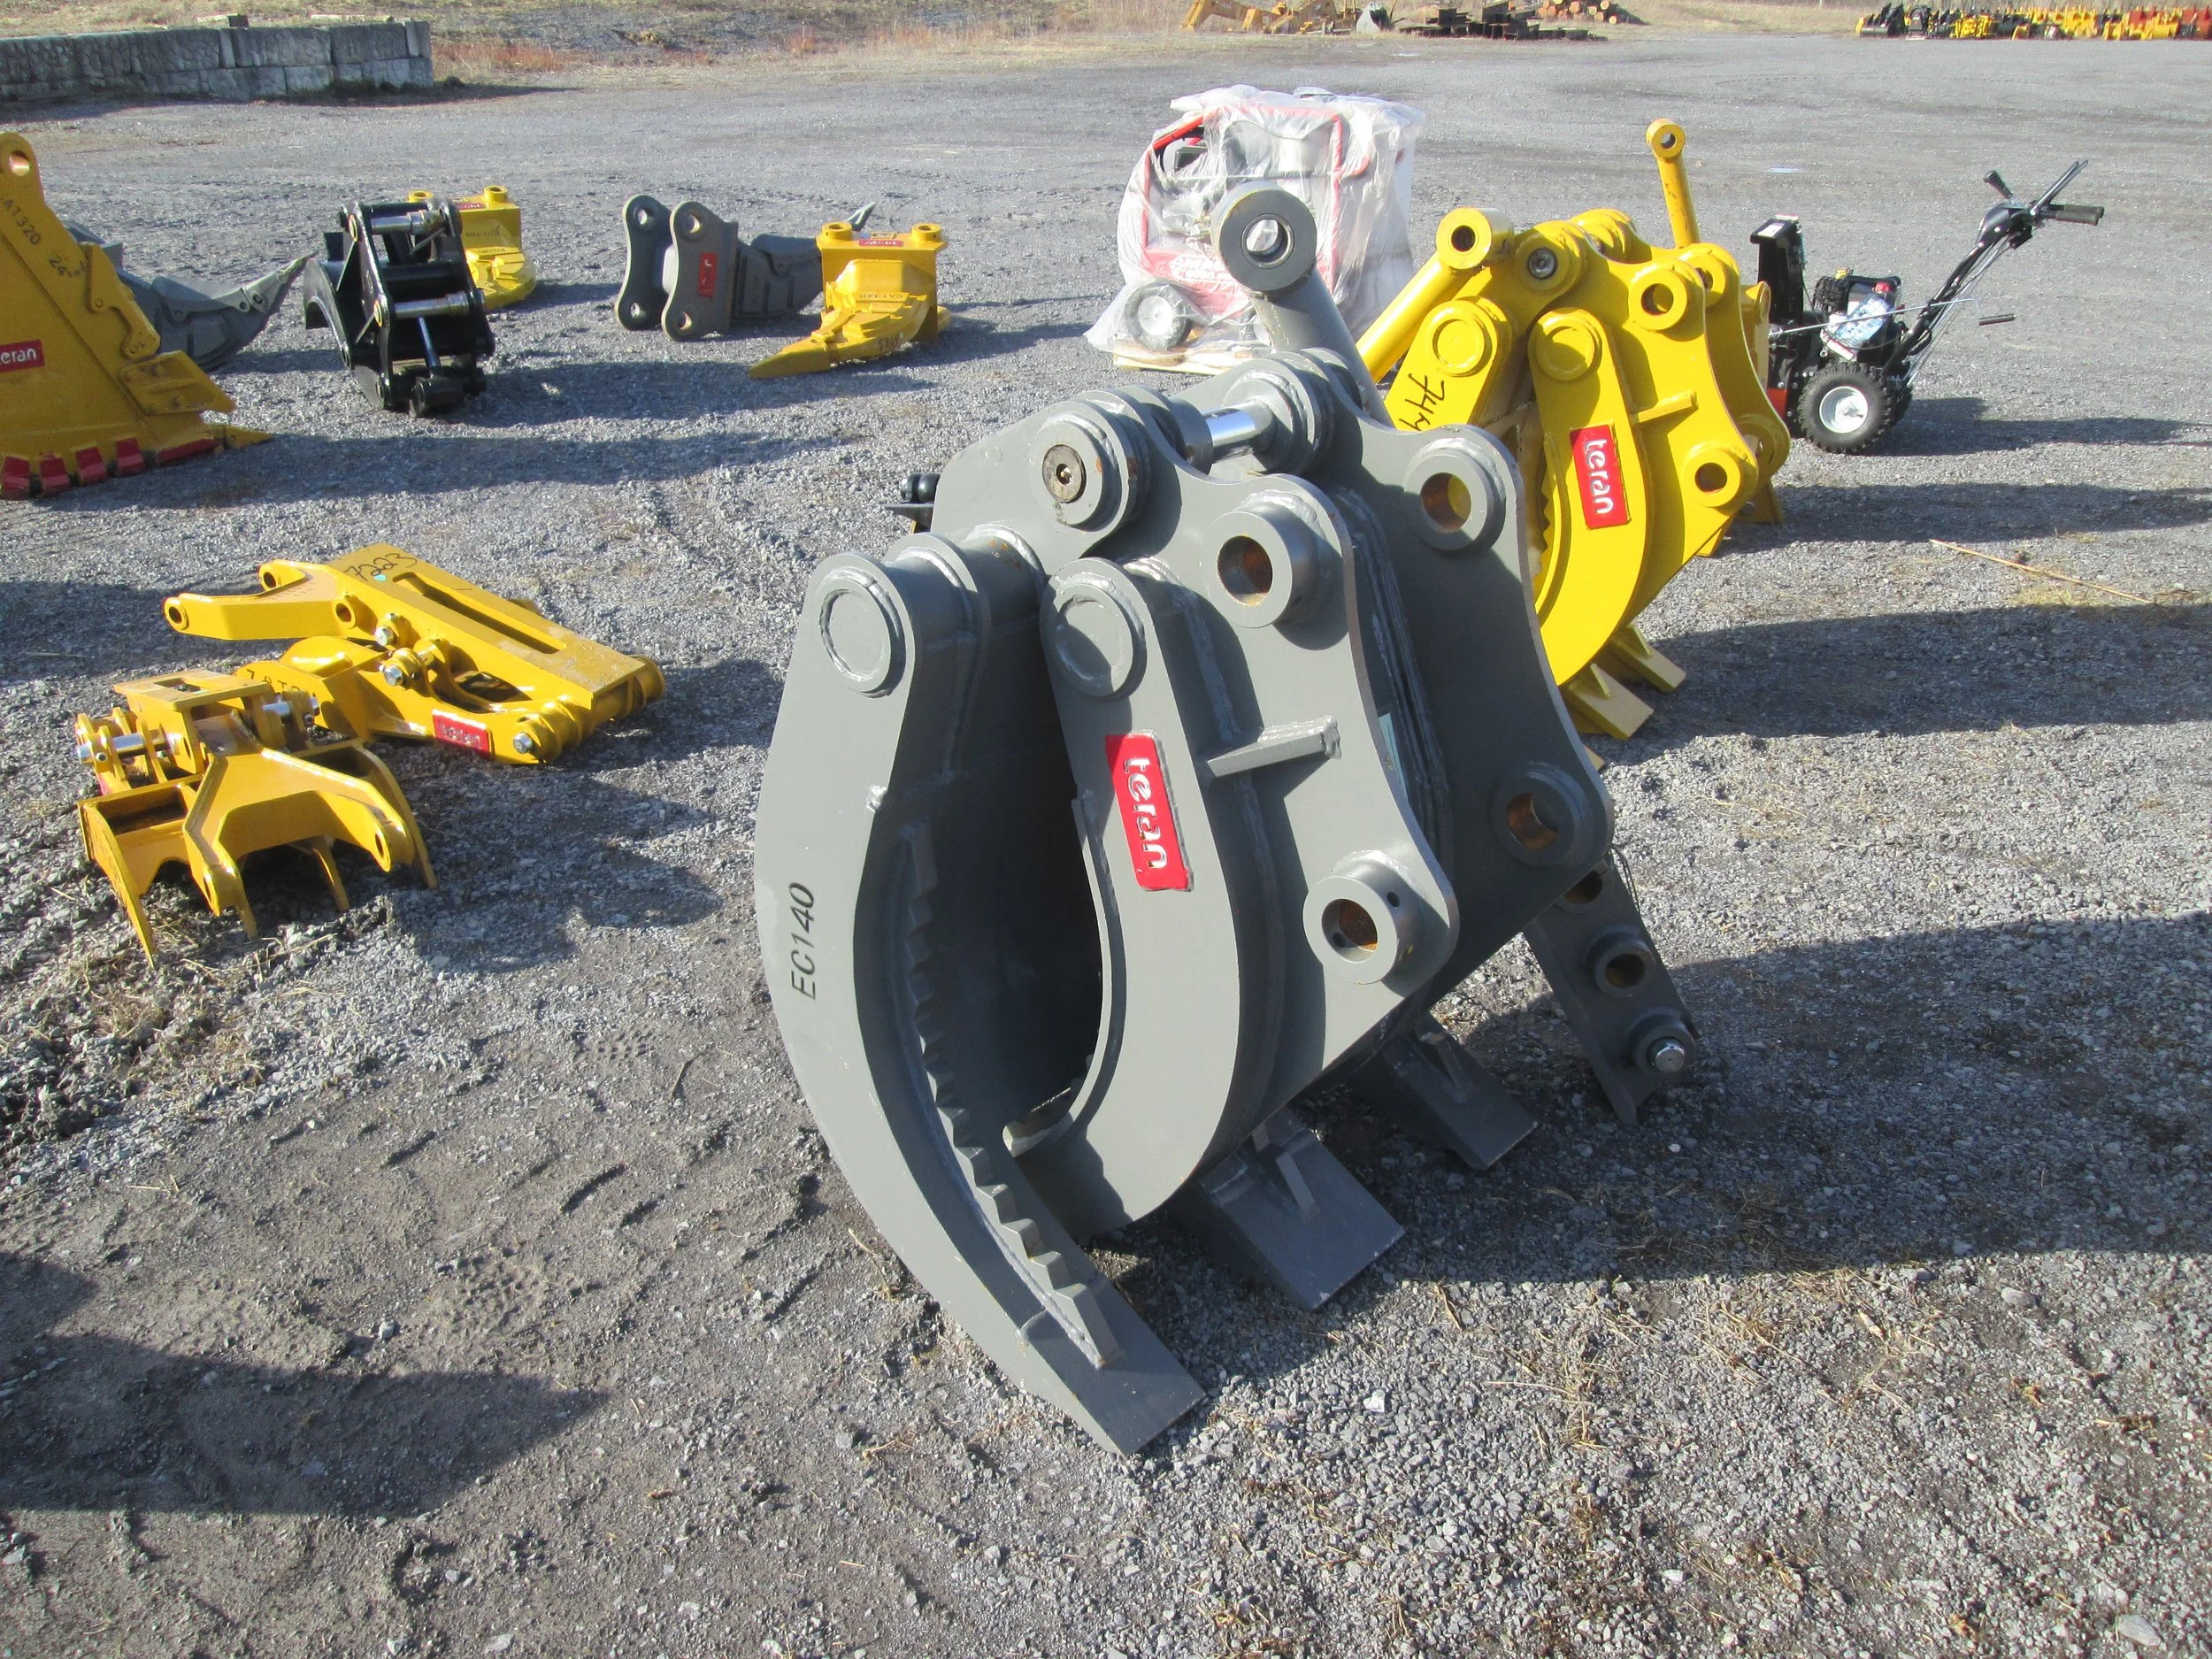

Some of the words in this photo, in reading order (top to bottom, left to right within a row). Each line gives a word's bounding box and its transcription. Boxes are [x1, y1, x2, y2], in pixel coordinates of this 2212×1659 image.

[0, 347, 37, 365] eran
[1585, 438, 1614, 515] teran
[342, 553, 418, 582] 7223
[1123, 757, 1168, 870] teran
[788, 881, 816, 1001] EC140
